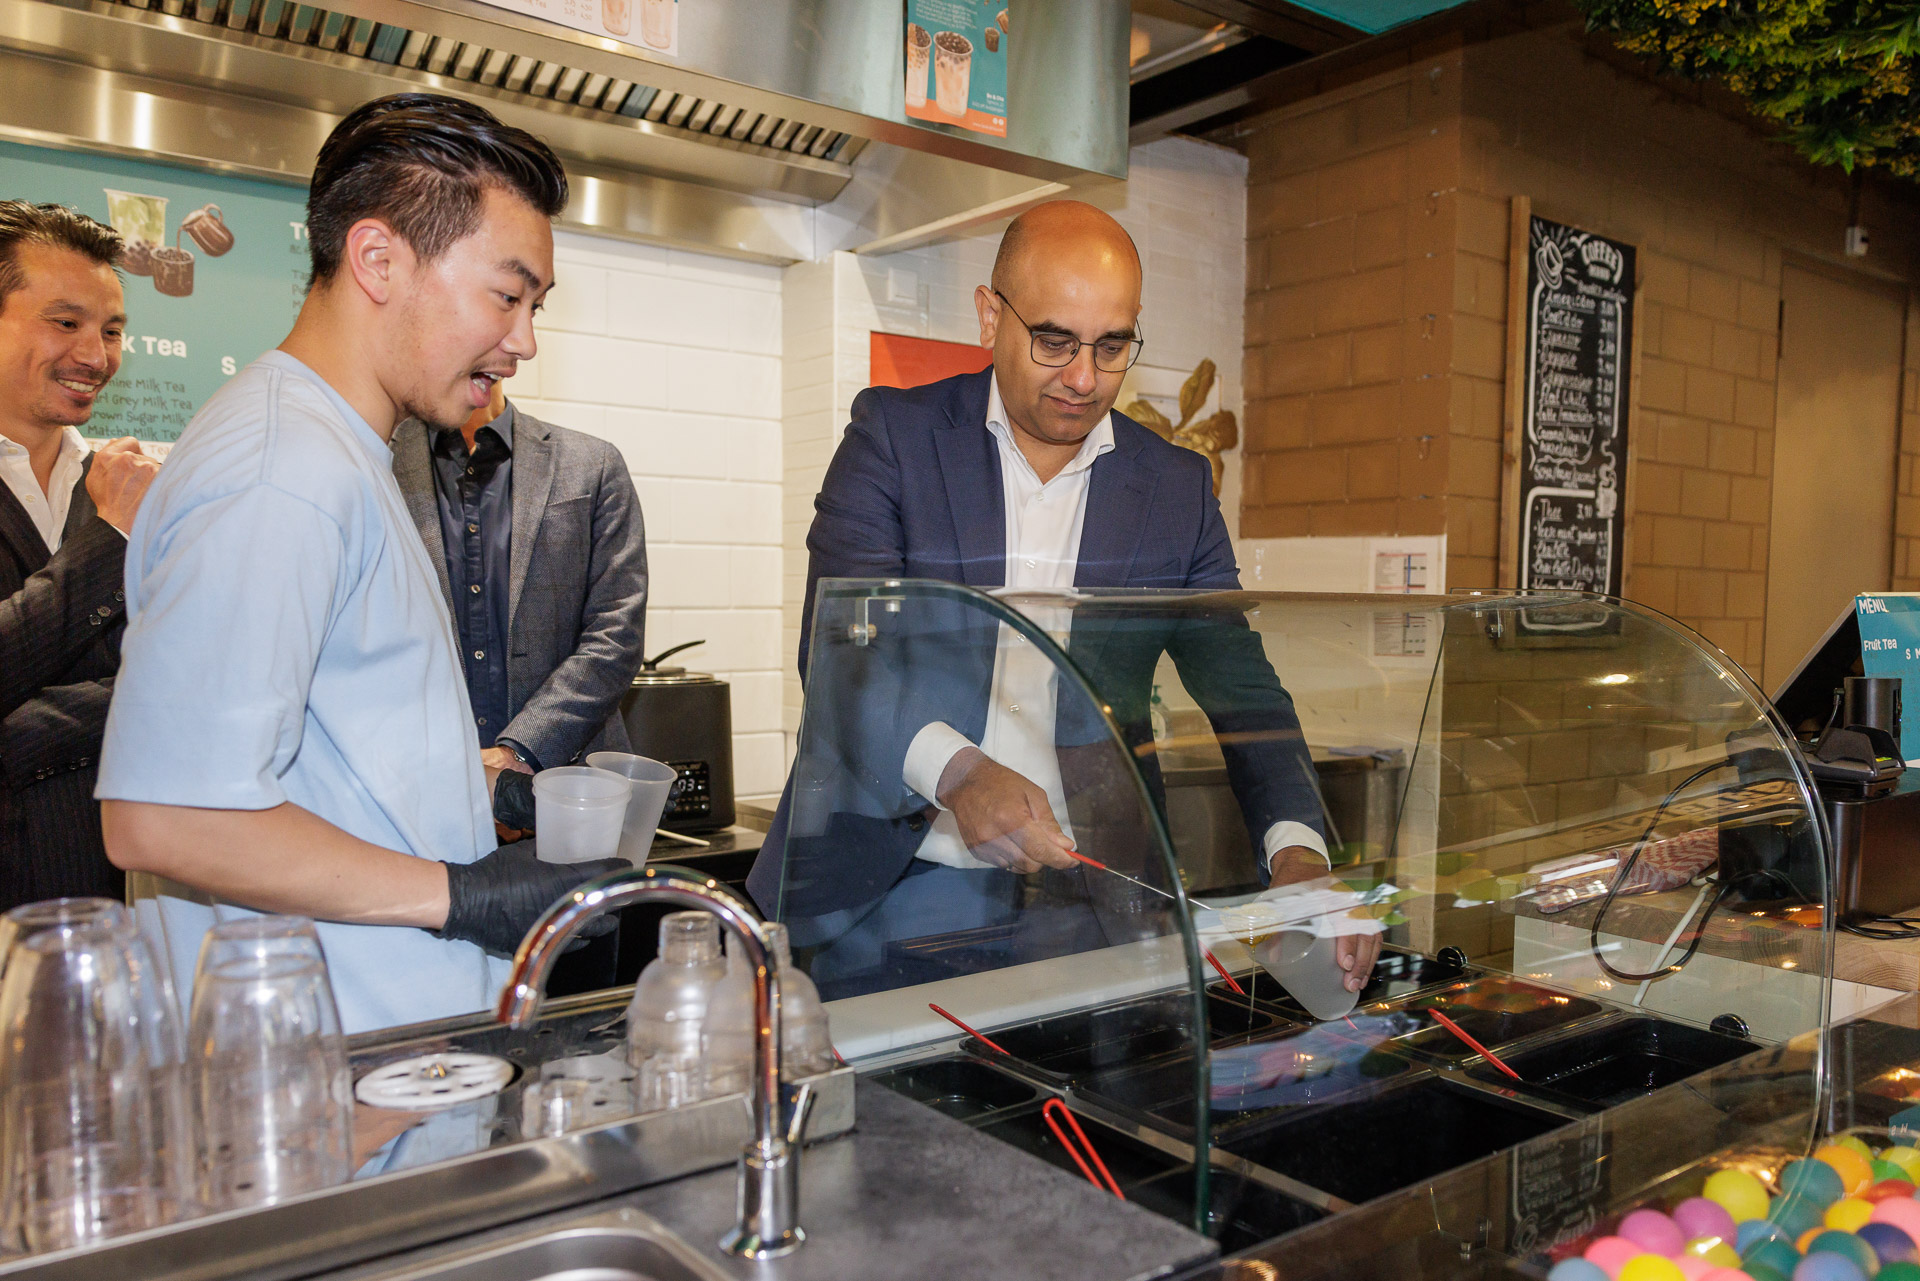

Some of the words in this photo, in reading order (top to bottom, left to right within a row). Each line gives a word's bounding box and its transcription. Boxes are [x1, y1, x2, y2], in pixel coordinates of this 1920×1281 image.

[1581, 240, 1617, 272] COFFEE
[141, 335, 187, 358] Tea
[221, 355, 236, 376] S
[135, 378, 161, 393] Milk
[164, 381, 186, 393] Tea
[112, 394, 138, 410] Grey
[143, 396, 168, 410] Milk
[170, 398, 193, 410] Tea
[126, 410, 158, 426] Sugar
[162, 412, 187, 427] Milk
[87, 425, 130, 436] Matcha
[133, 426, 158, 441] Milk
[1858, 597, 1889, 615] MENU
[1863, 639, 1881, 651] Fruit
[1882, 638, 1898, 650] Tea
[1905, 647, 1912, 660] S
